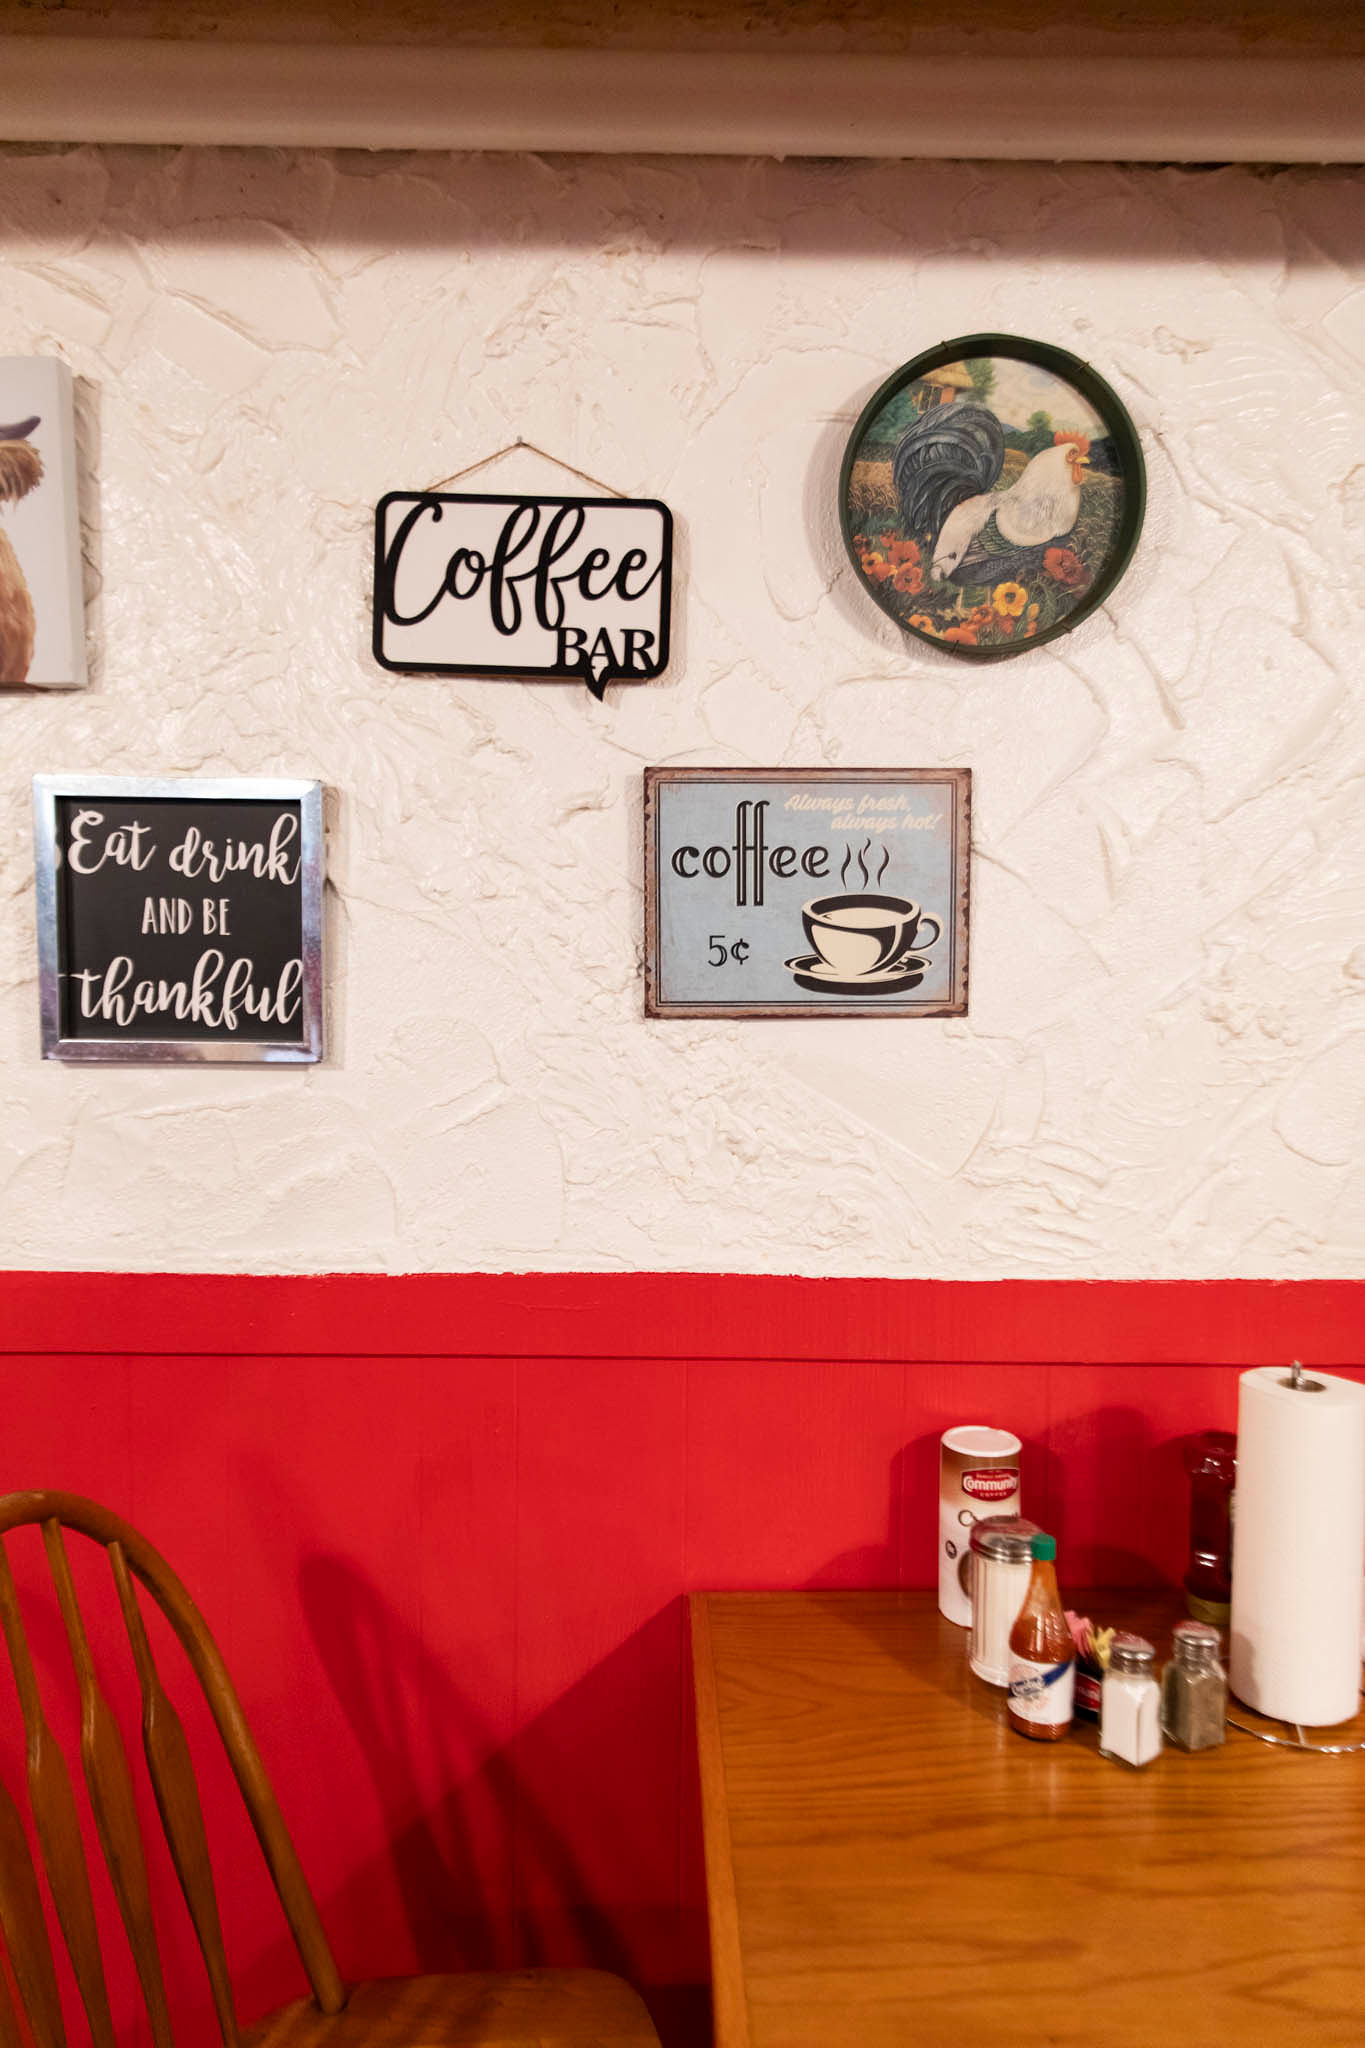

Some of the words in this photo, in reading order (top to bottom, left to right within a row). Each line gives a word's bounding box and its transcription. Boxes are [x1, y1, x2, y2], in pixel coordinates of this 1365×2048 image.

[383, 499, 663, 635] Coffee
[552, 627, 659, 674] BAR
[784, 794, 856, 814] Always
[831, 812, 897, 833] always
[901, 812, 943, 830] hot!
[68, 809, 156, 874] Eat
[169, 813, 301, 885] drink
[671, 800, 831, 906] coffee
[141, 897, 192, 934] AND
[203, 898, 231, 935] BE
[707, 935, 750, 967] 5¢
[71, 949, 303, 1030] thankful
